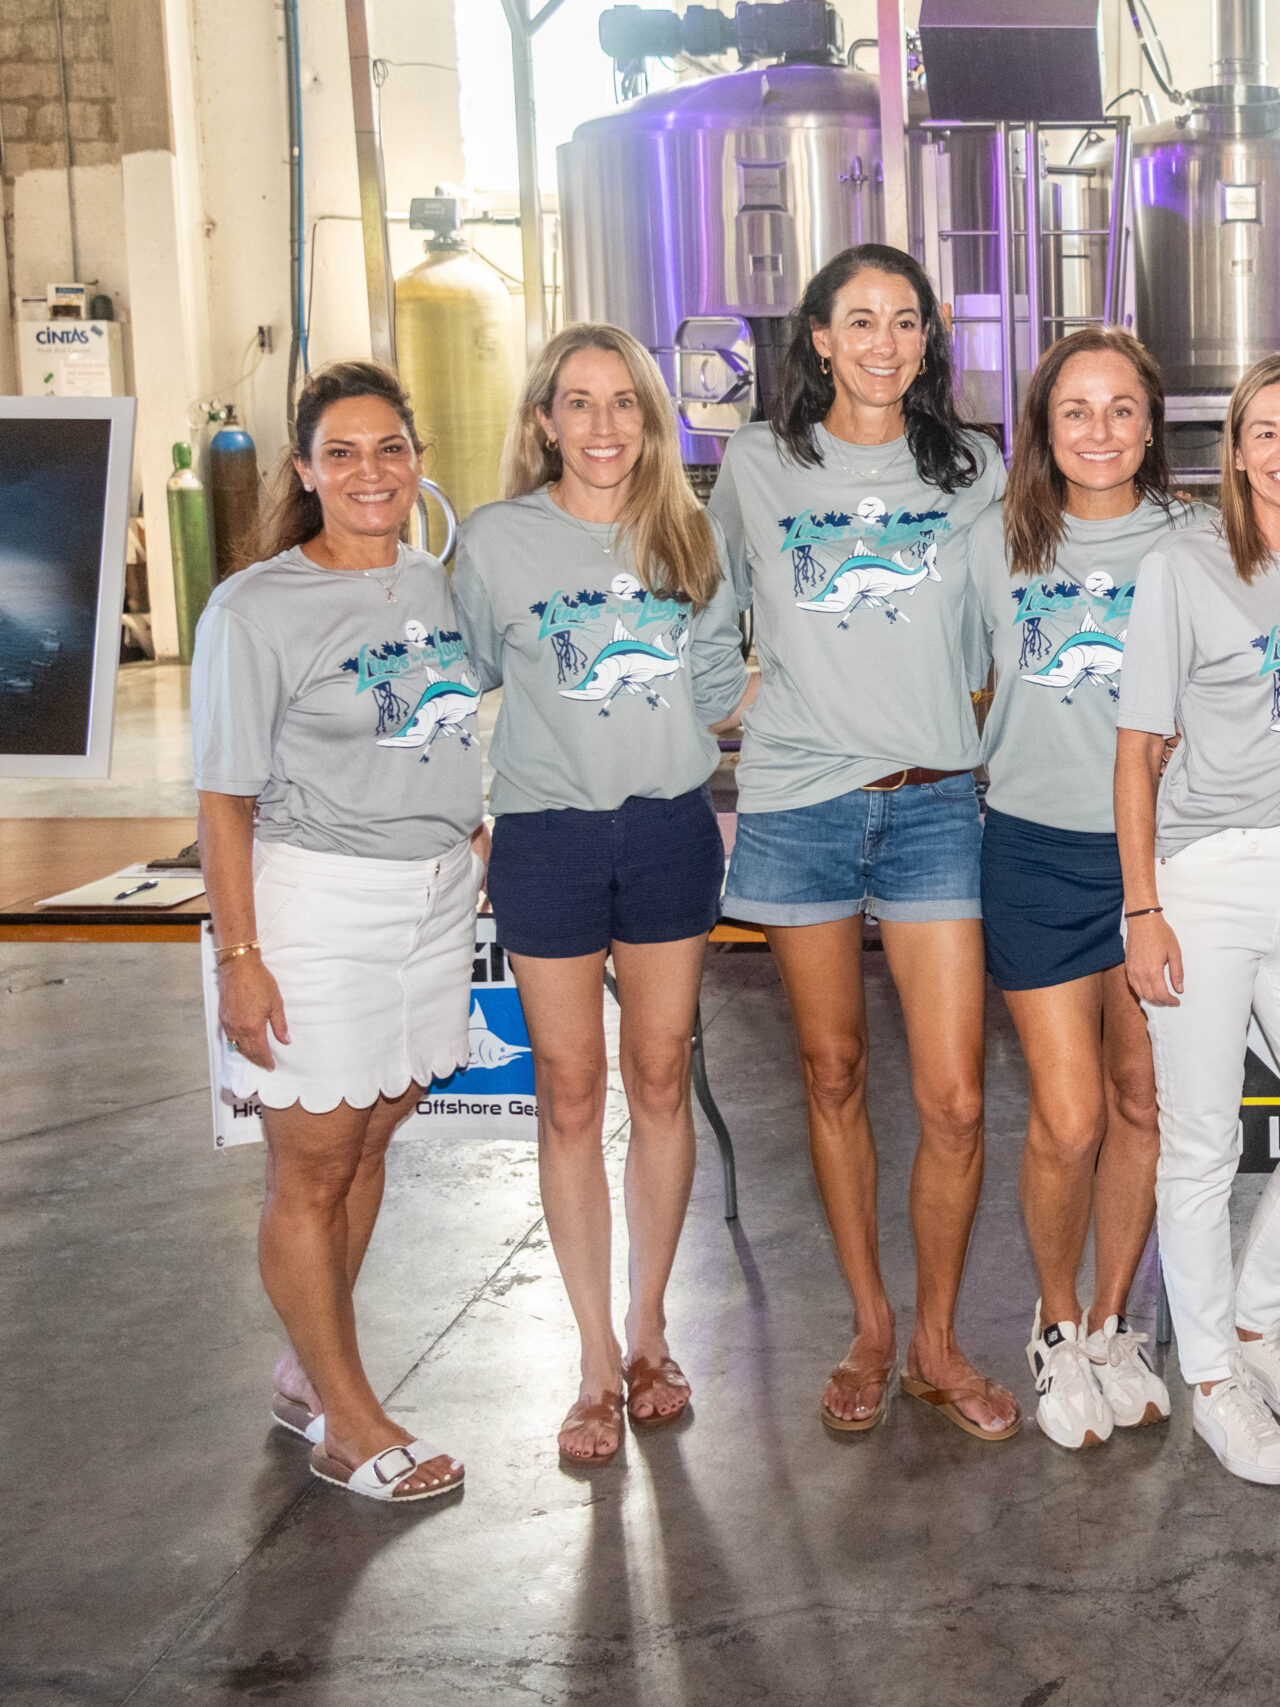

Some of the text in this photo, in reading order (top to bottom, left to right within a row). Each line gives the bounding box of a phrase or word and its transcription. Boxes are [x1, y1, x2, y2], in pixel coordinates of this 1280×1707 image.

[779, 508, 845, 553] Lines
[876, 506, 953, 548] Lagoon
[538, 589, 602, 641] Lines
[1012, 578, 1075, 626] Lines
[355, 643, 410, 695] Lines
[415, 1099, 503, 1115] Offshore
